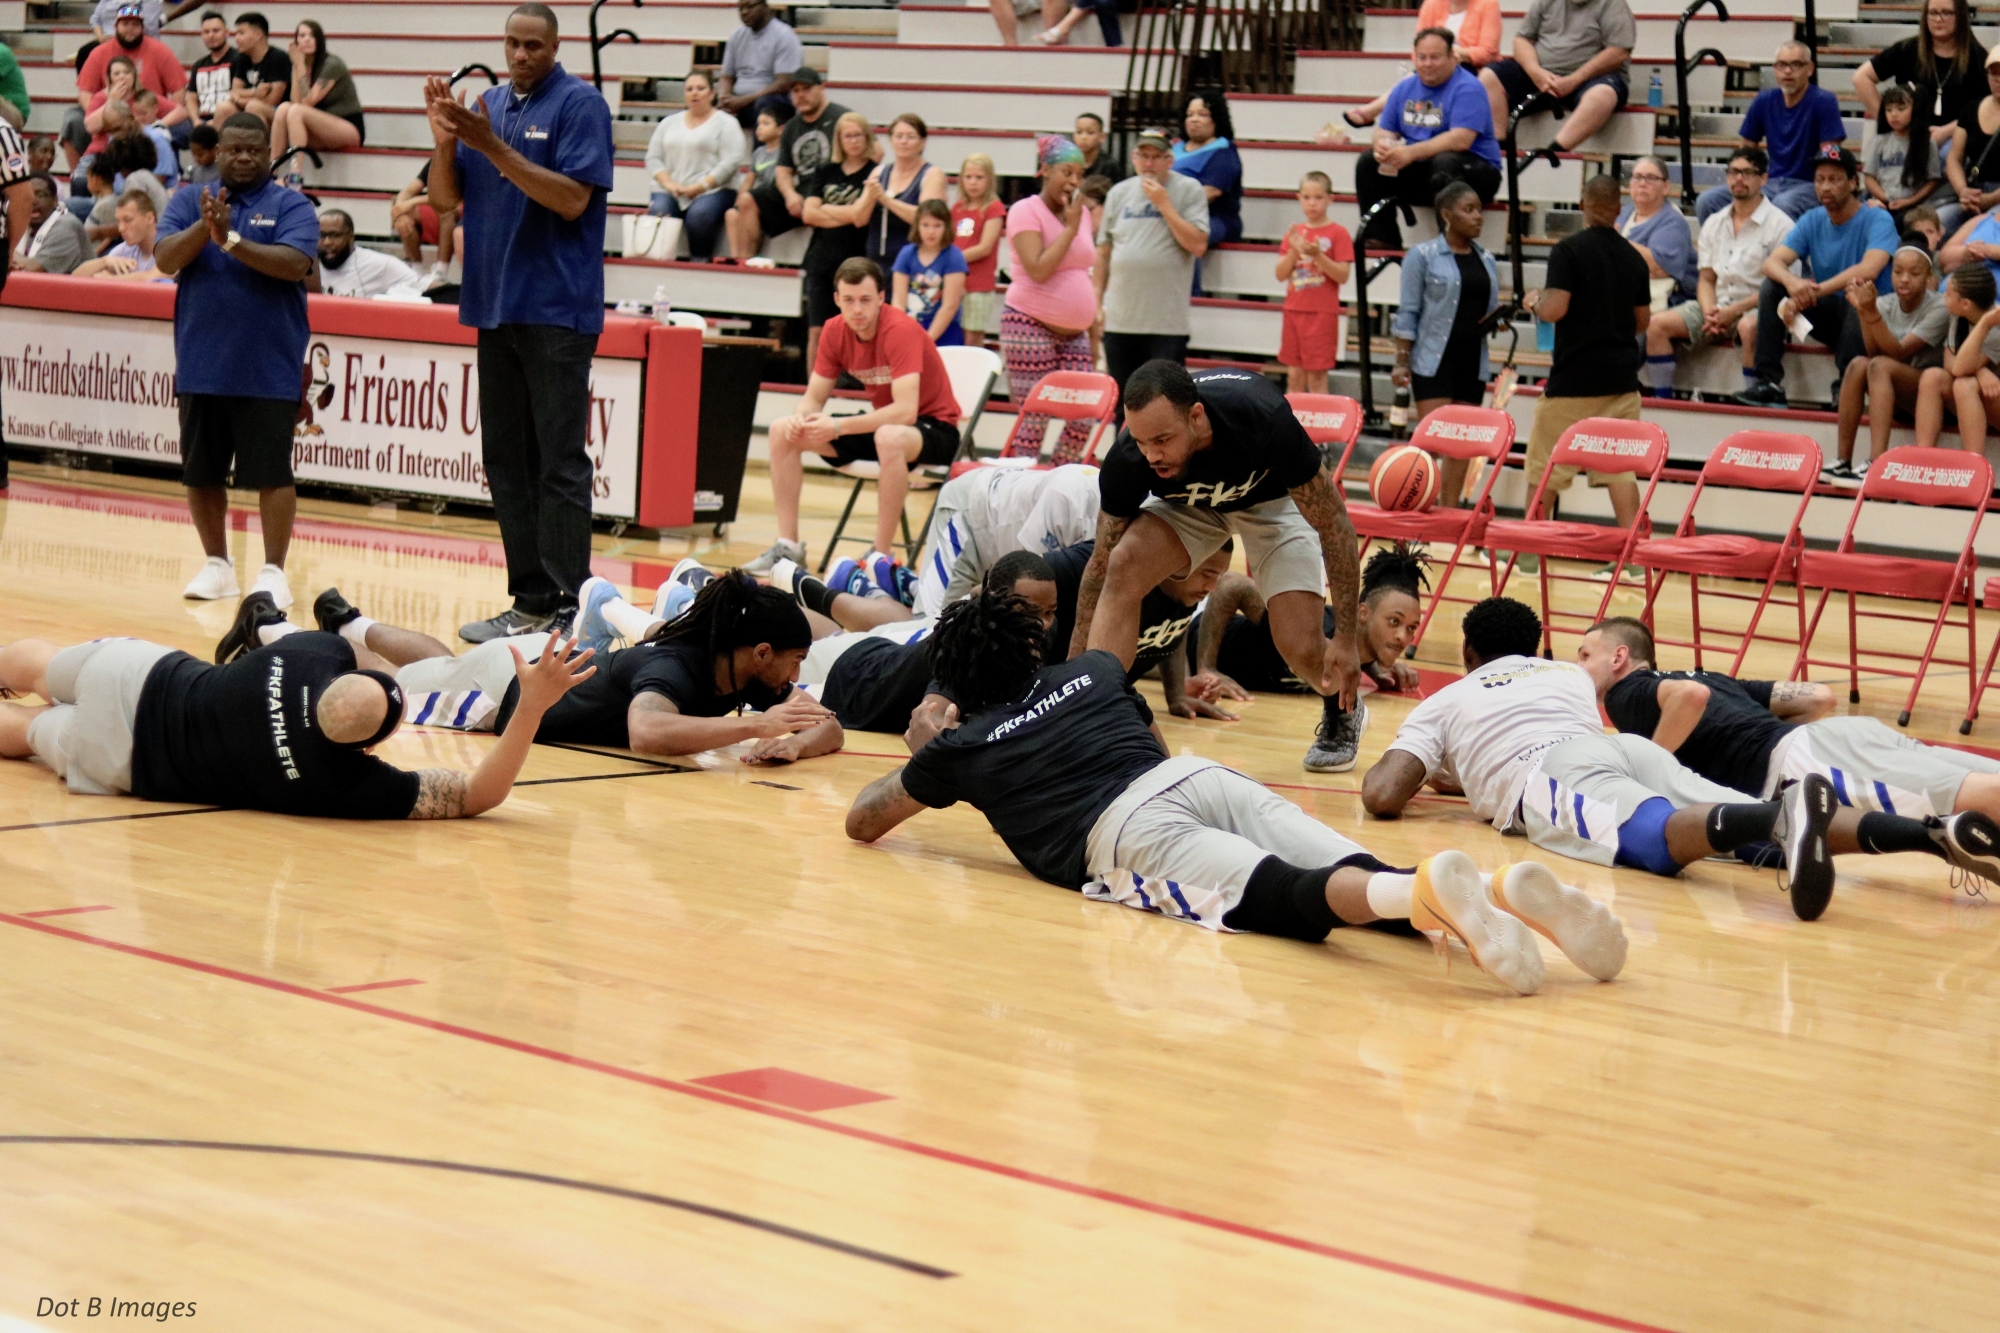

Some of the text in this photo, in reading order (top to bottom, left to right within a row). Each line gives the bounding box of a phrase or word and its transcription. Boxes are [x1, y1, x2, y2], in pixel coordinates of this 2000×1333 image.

[341, 352, 448, 432] Friends
[8, 415, 46, 438] Kansas
[49, 420, 103, 448] Collegiate
[106, 428, 150, 452] Athletic
[294, 439, 490, 493] partment of Intercolleg
[268, 655, 300, 780] #FKFATHLETE
[986, 674, 1093, 742] #FKFATHLETE
